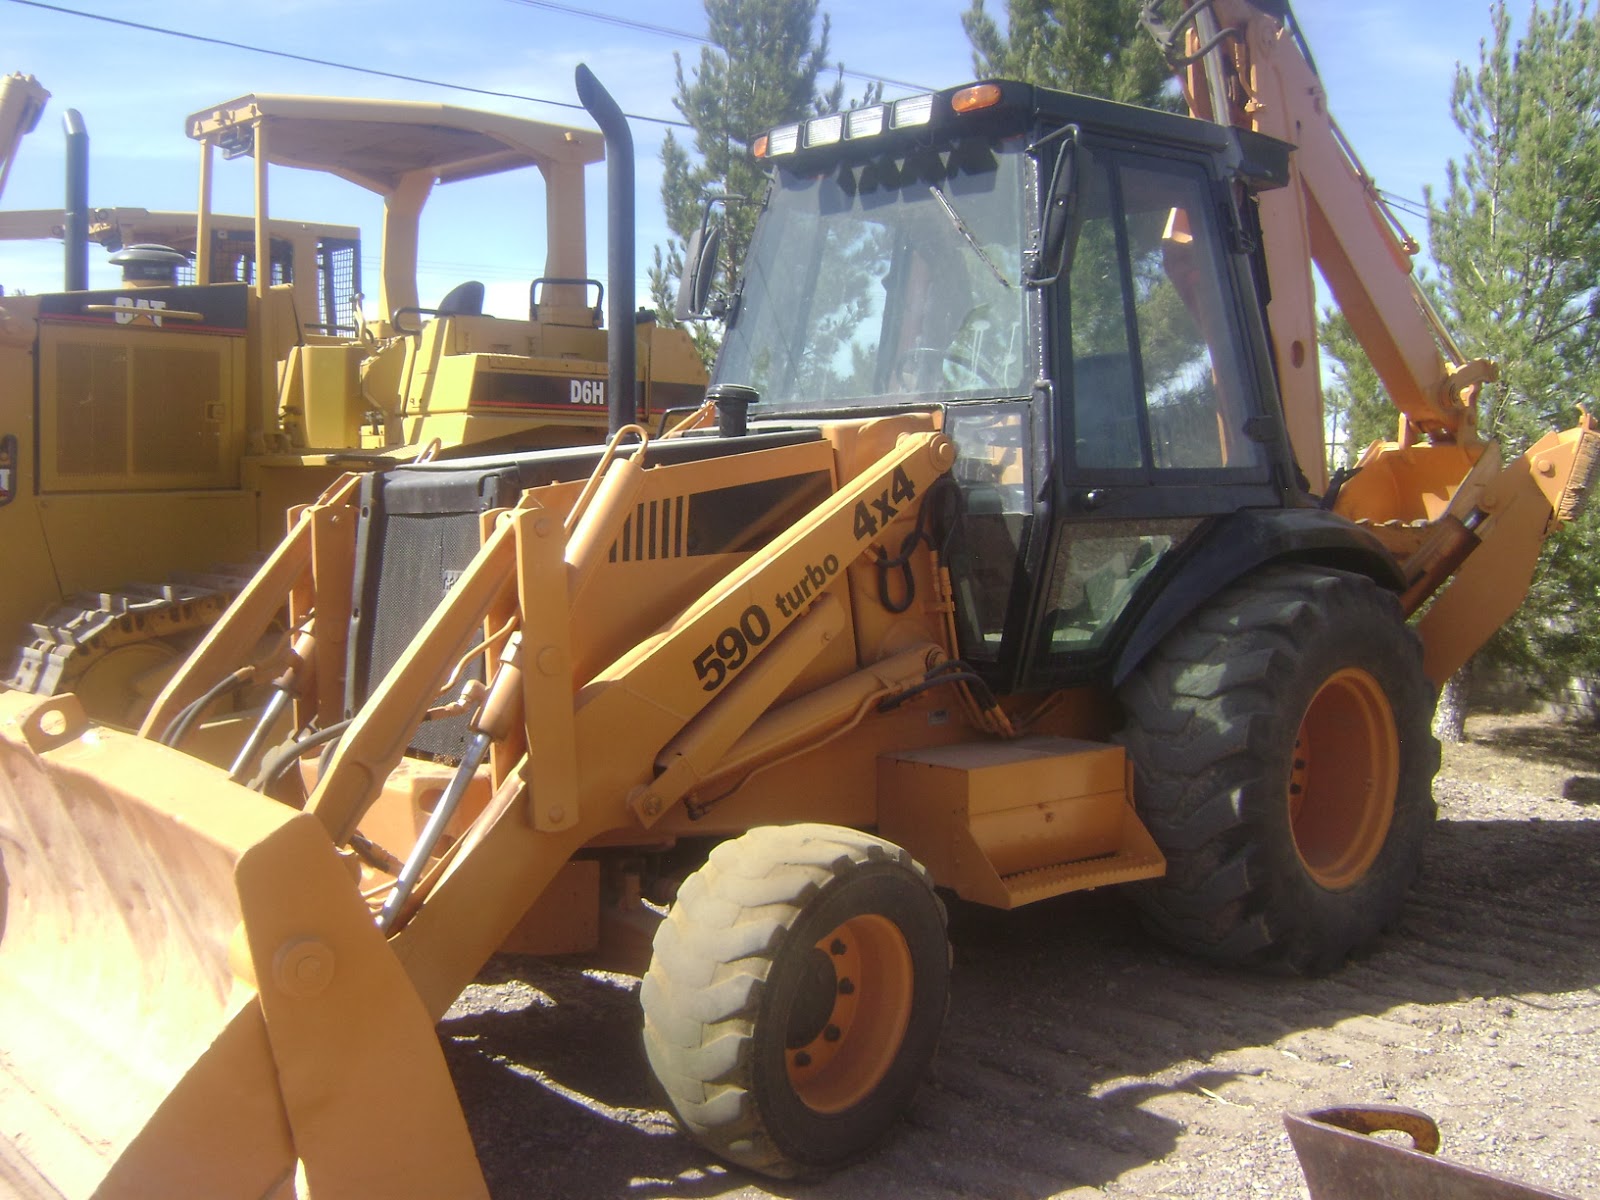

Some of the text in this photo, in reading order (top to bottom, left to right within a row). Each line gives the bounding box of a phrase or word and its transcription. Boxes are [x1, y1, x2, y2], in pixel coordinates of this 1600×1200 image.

[115, 297, 166, 327] CAT
[570, 379, 604, 404] D6H
[692, 464, 915, 692] 590 turbo 4x4
